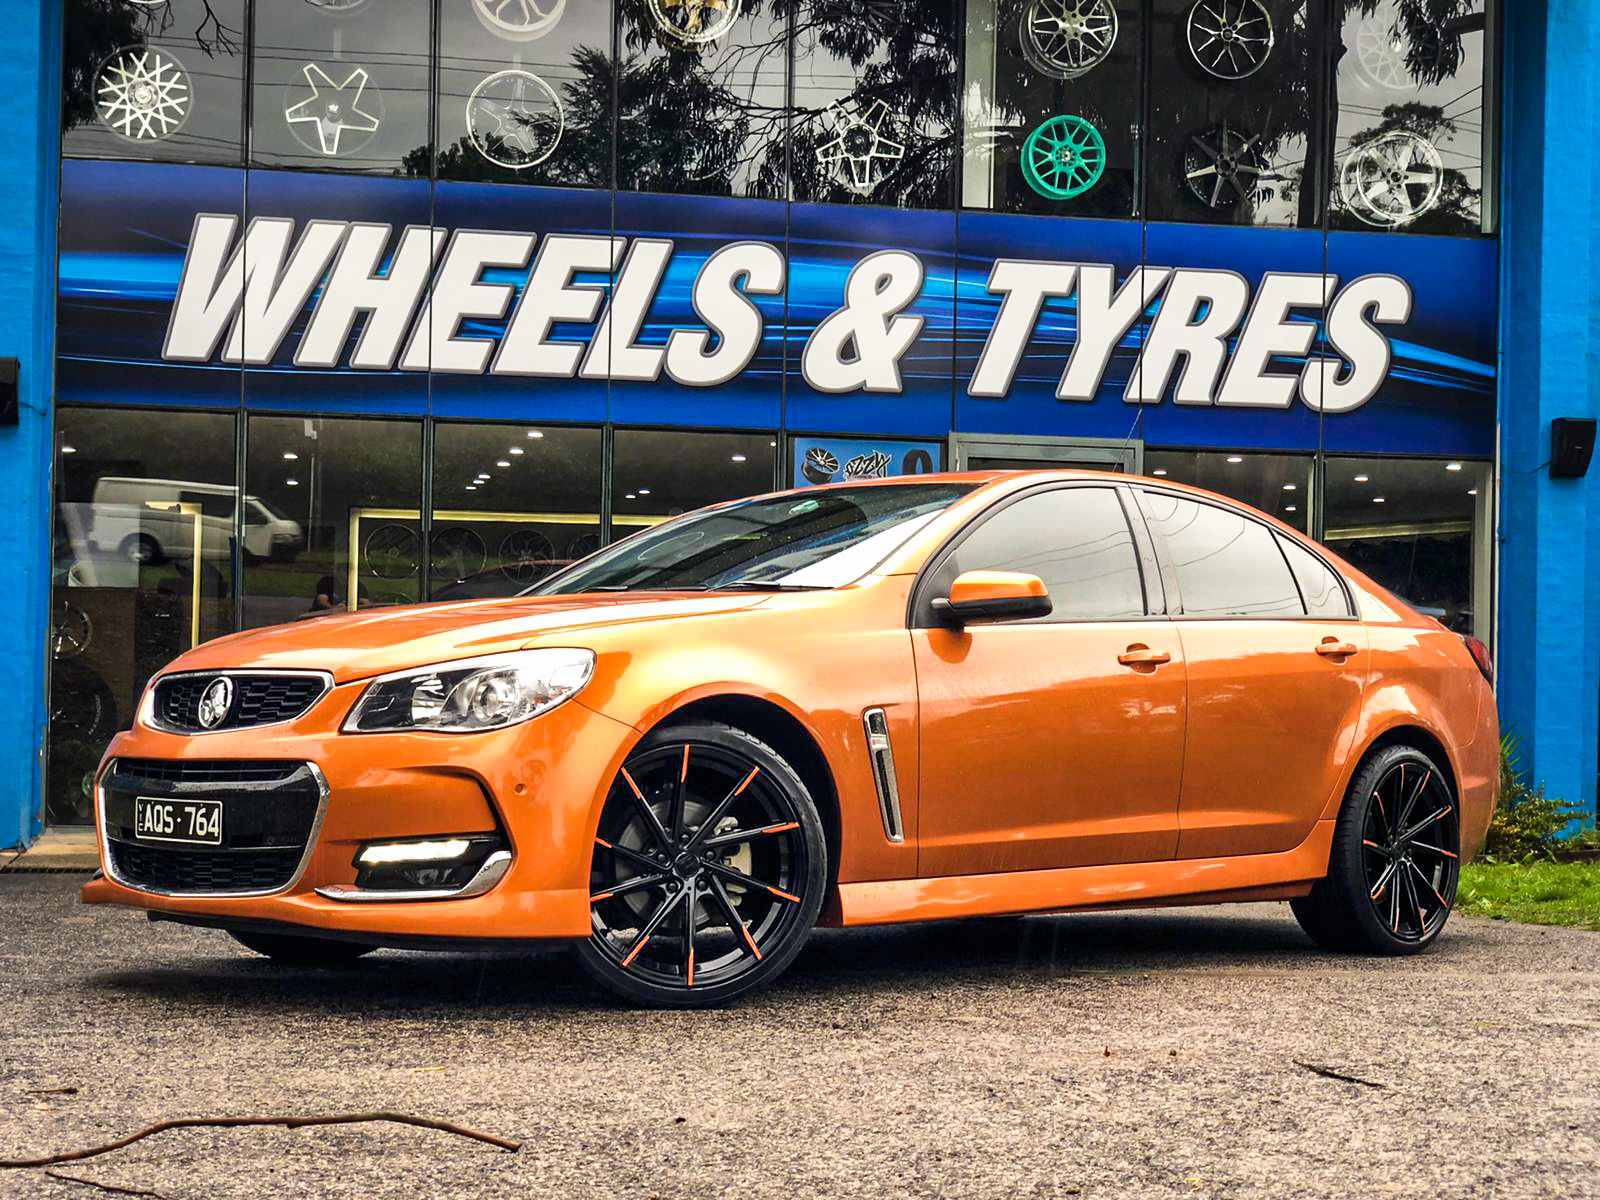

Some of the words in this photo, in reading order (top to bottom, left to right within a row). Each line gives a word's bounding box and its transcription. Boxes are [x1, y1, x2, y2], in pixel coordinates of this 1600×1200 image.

[162, 213, 785, 386] WHEELS
[803, 250, 923, 393] &
[968, 258, 1412, 412] TYRES
